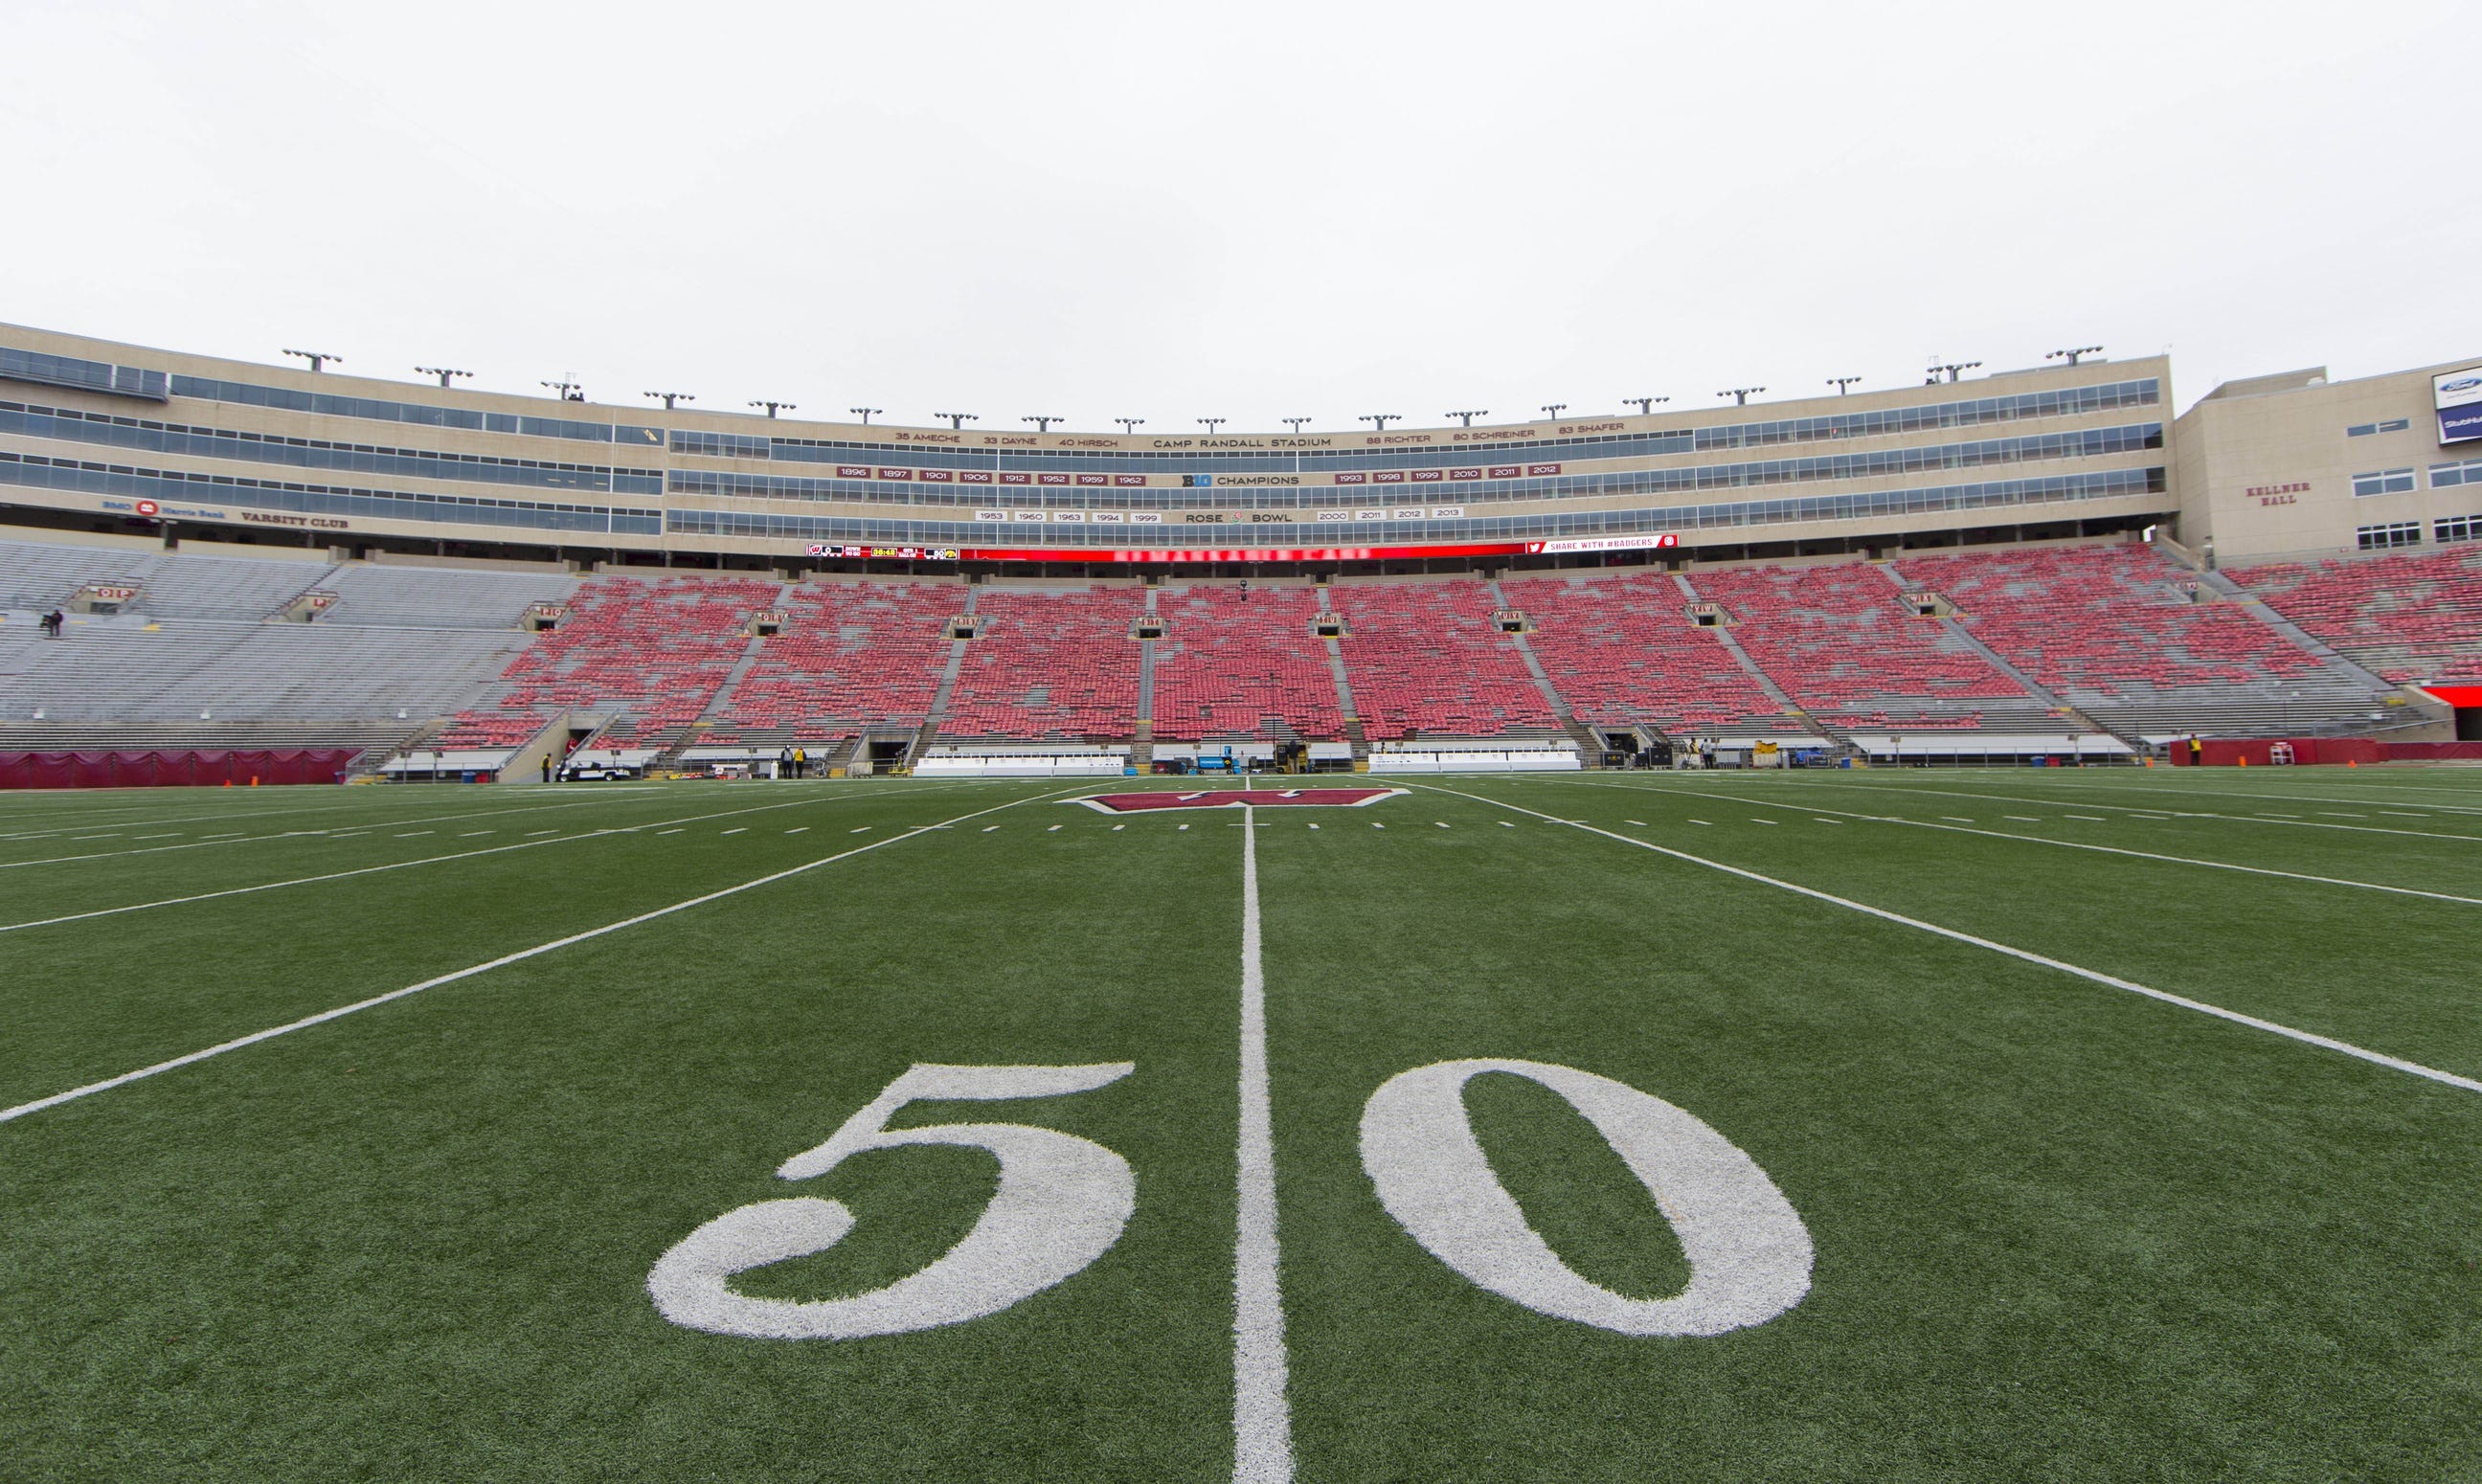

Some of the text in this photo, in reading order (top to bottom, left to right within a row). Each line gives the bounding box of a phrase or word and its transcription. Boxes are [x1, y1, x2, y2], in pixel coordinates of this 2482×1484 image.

[1559, 422, 1625, 435] 83 SHAFER
[913, 434, 960, 443] AMECHE
[1385, 435, 1432, 444] RICHTER
[1454, 430, 1536, 441] 80 SCHREINER
[1002, 438, 1037, 446] DAYNE
[1153, 439, 1192, 448] CAMP
[1271, 438, 1331, 447] STADIUM
[883, 469, 907, 478] 1897
[925, 471, 947, 480] 1901
[963, 473, 988, 482] 1906
[1340, 474, 1363, 483] 1993
[1415, 471, 1439, 480] 1999
[1533, 465, 1556, 474] 2012
[1217, 476, 1299, 485] CHAMPIONS
[2245, 483, 2311, 497] KELLNER
[2261, 494, 2296, 506] HALL
[241, 512, 349, 528] VARSITY CLUB
[1185, 513, 1293, 523] ROSE BOWL
[1550, 542, 1577, 551] SHARE
[1607, 538, 1653, 548] #BADGERS
